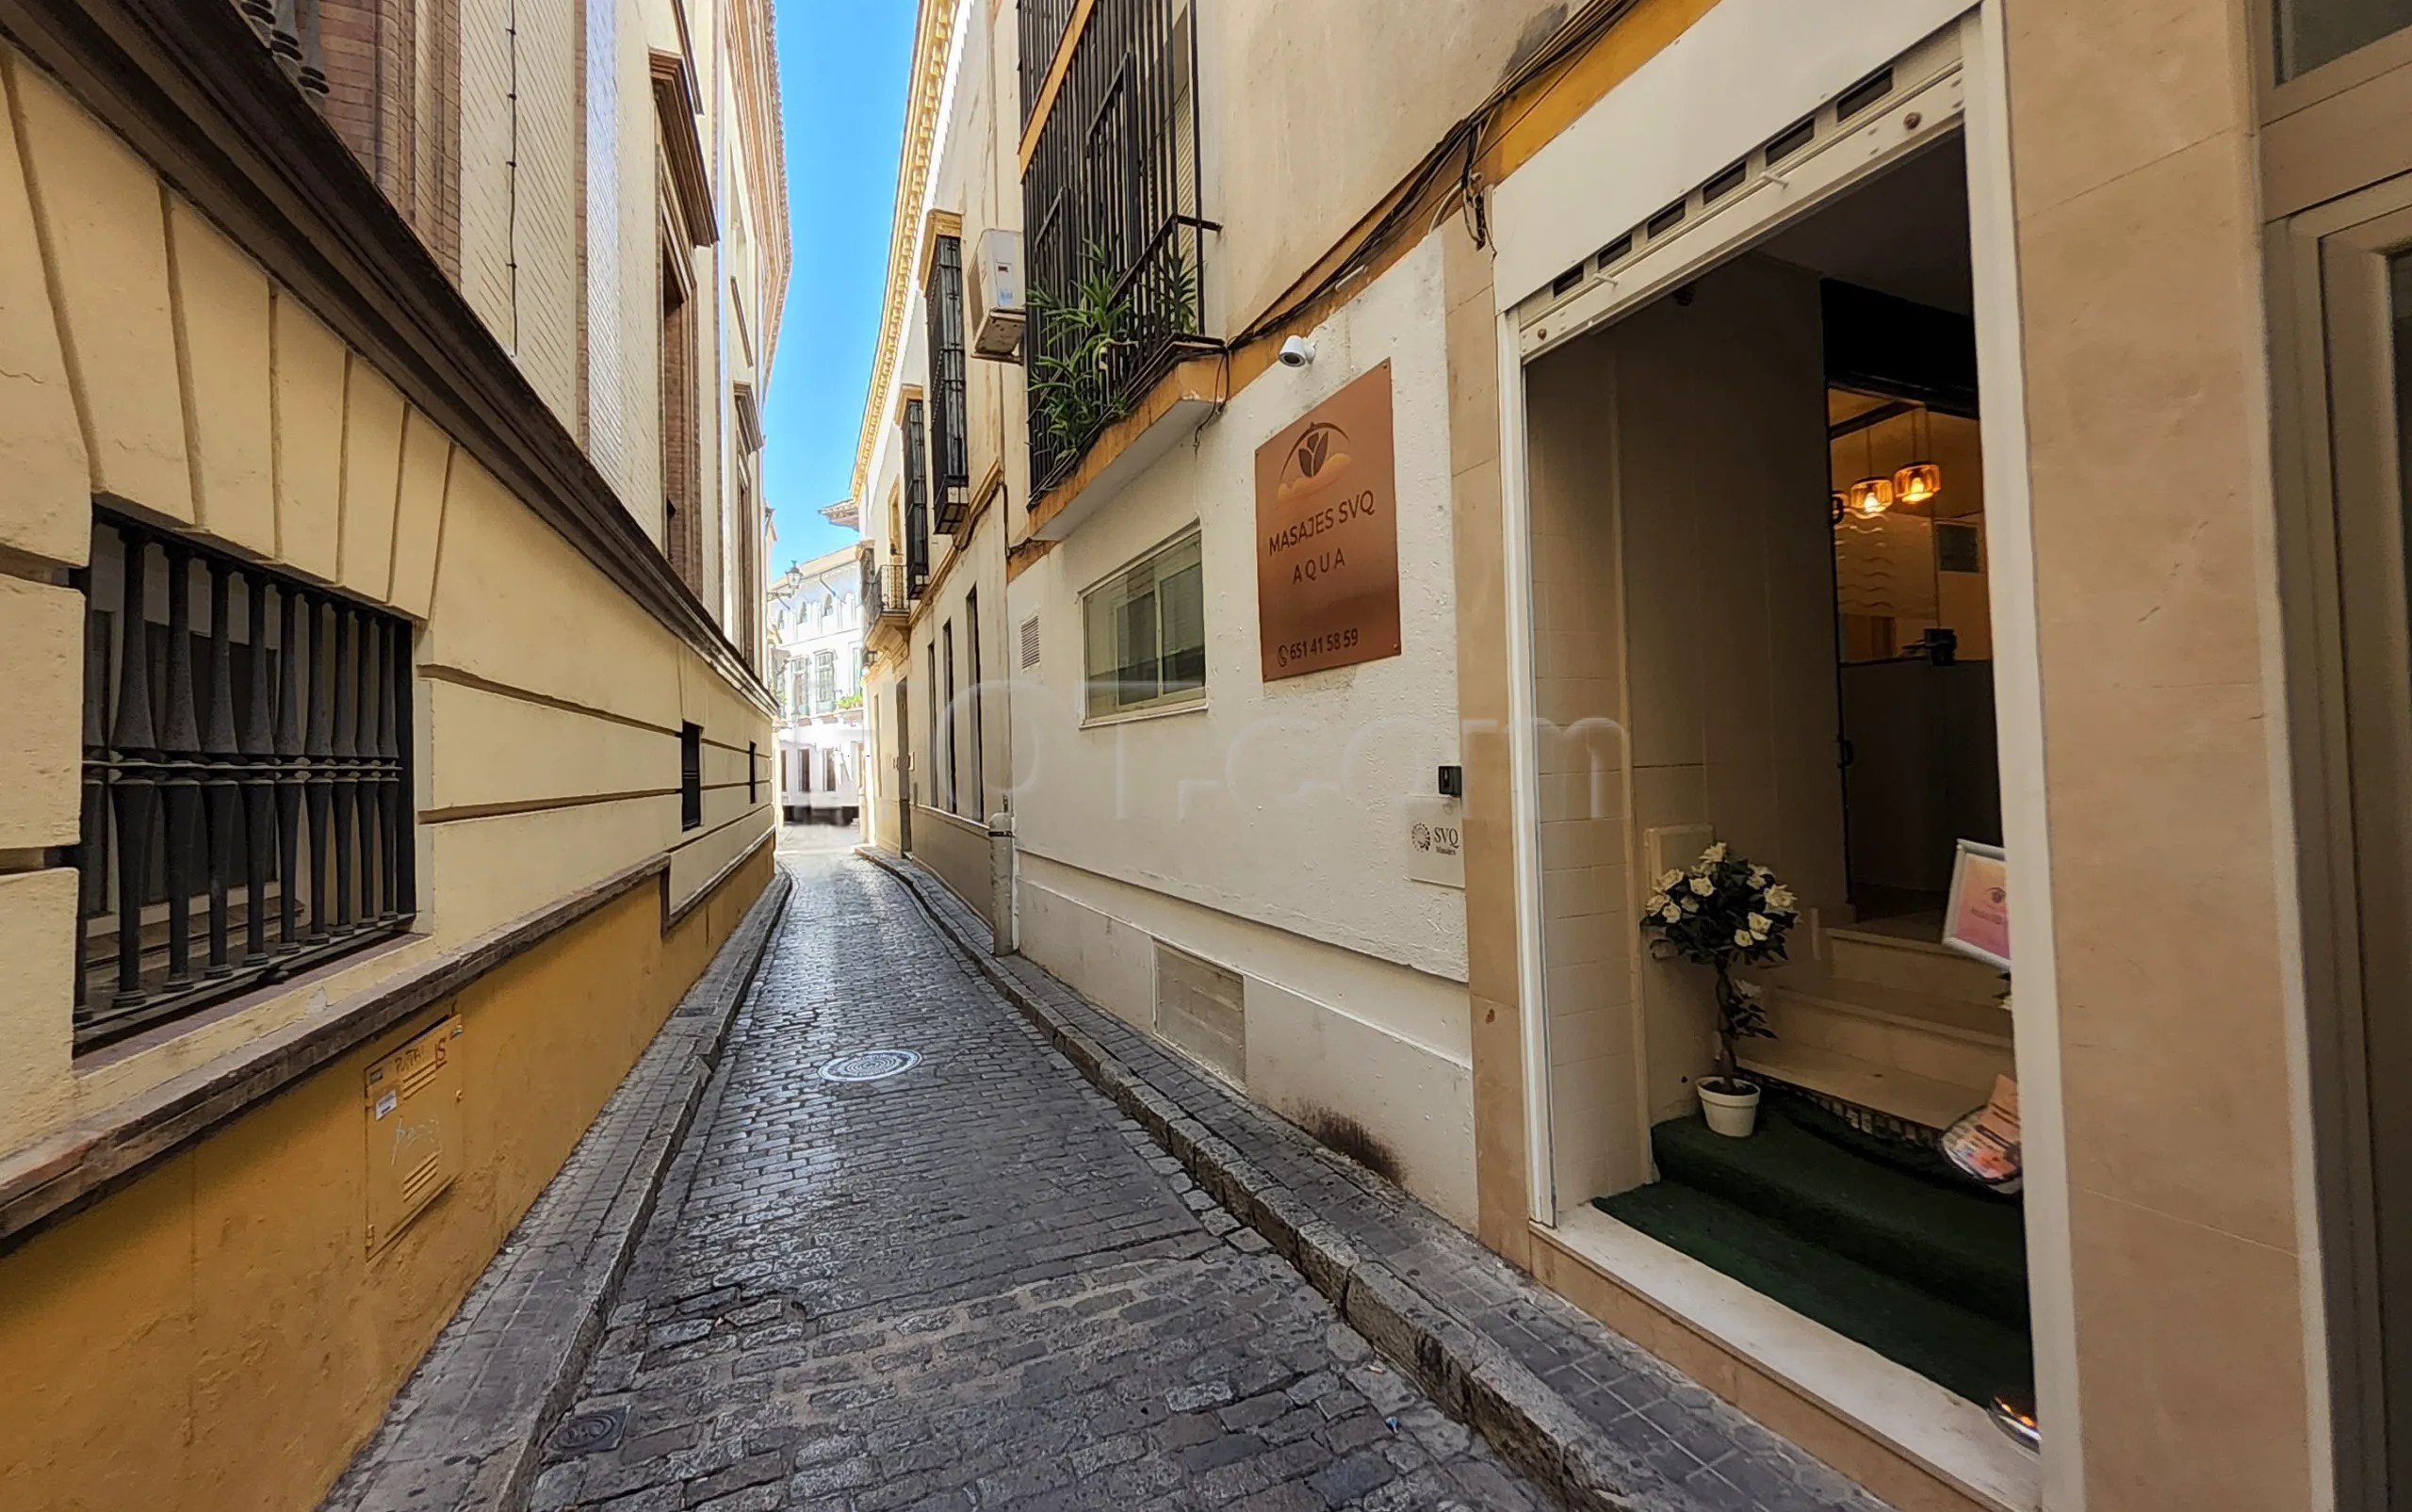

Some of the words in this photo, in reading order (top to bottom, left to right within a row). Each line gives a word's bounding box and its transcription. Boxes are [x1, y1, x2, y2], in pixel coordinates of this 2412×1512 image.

[1269, 508, 1334, 557] MASAJES
[1338, 489, 1375, 524] SVQ
[1293, 547, 1345, 585] AQUA
[1290, 641, 1308, 660] 651
[1310, 637, 1323, 655] 41
[1327, 632, 1341, 652] 58
[1343, 627, 1359, 648] 59
[1434, 826, 1459, 849] SVQ
